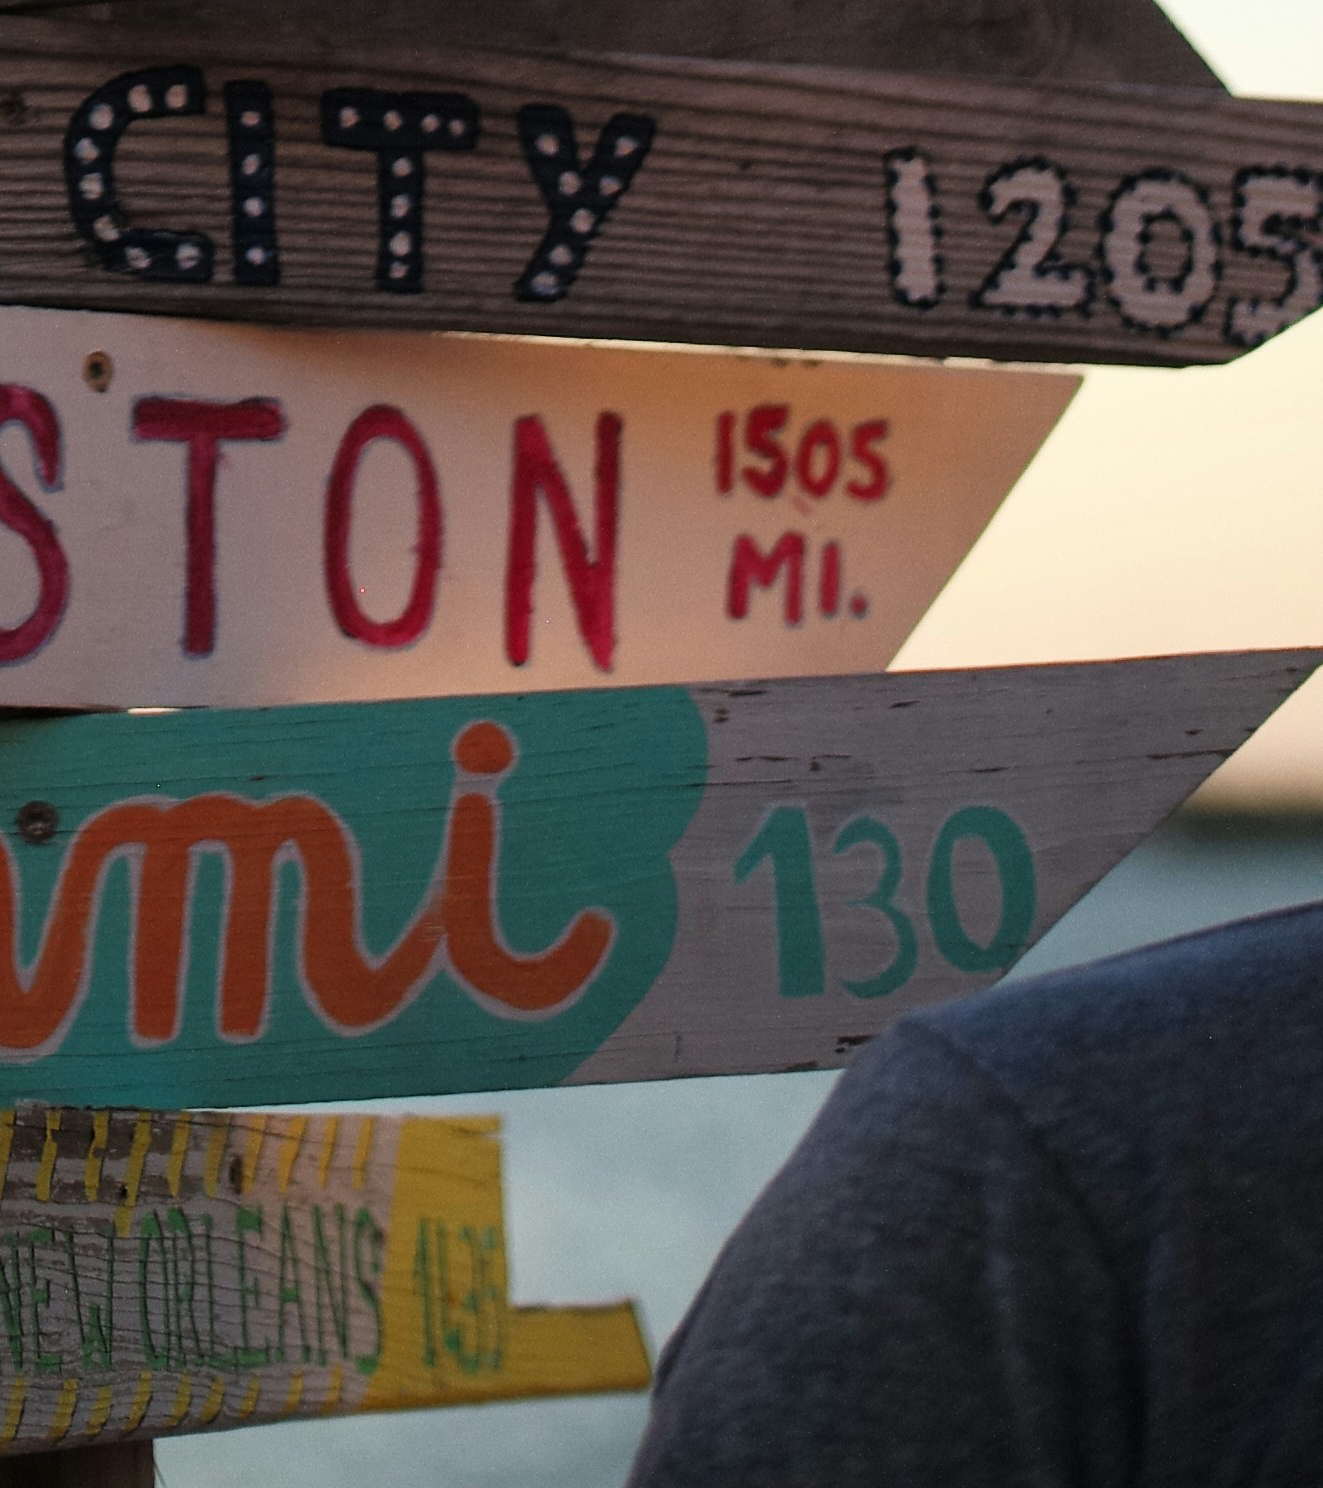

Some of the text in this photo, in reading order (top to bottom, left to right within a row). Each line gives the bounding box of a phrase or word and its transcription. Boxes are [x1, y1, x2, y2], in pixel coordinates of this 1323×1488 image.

[63, 64, 658, 302] CITY
[880, 144, 1323, 344] 1205
[714, 401, 893, 503] 1505
[725, 529, 872, 628] MI.
[730, 802, 1039, 1002] 130
[135, 1204, 384, 1376] ORLEANS
